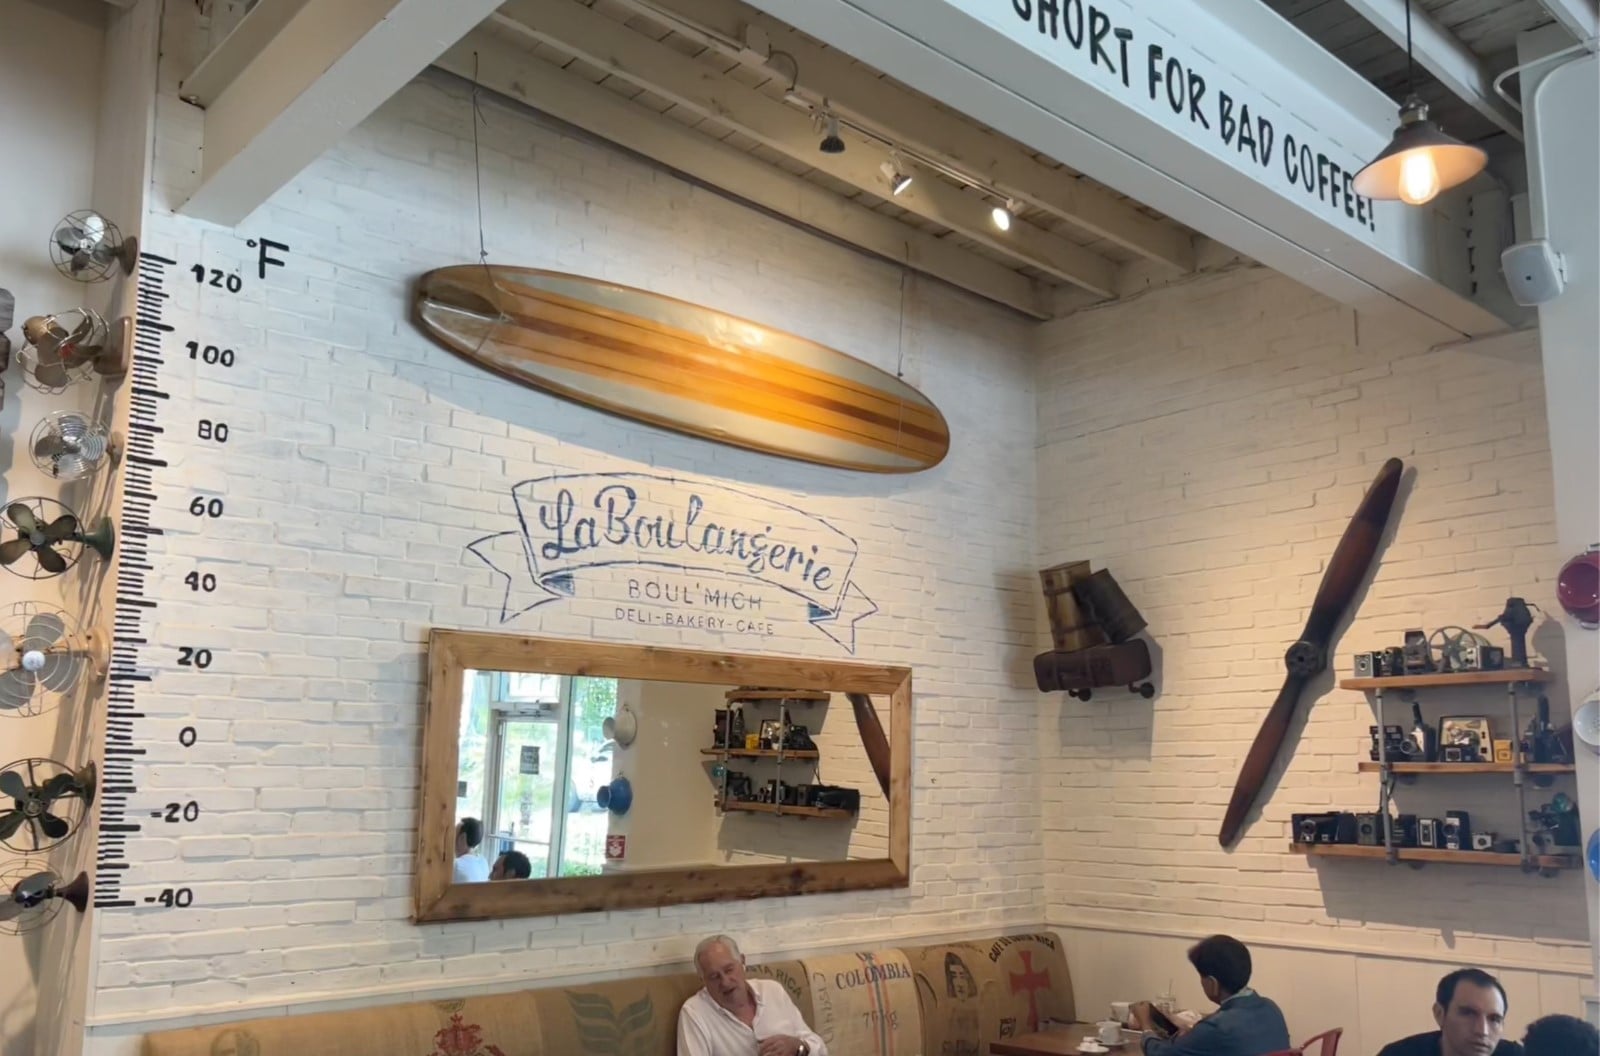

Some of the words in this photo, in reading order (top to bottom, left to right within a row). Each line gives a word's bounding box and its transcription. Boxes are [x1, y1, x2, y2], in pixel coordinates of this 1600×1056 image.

[1148, 44, 1210, 129] FOR
[1219, 90, 1273, 168] BAD
[1284, 133, 1375, 232] COFFEE!
[190, 263, 243, 293] 120
[185, 340, 235, 367] 100
[197, 419, 229, 443] 80
[189, 496, 224, 518] 60
[539, 488, 600, 560] La
[184, 571, 217, 593] 40
[177, 646, 213, 669] 20
[178, 726, 197, 747] 0
[150, 801, 200, 823] -20
[144, 887, 193, 909] -40
[835, 962, 912, 990] COLOMBIA
